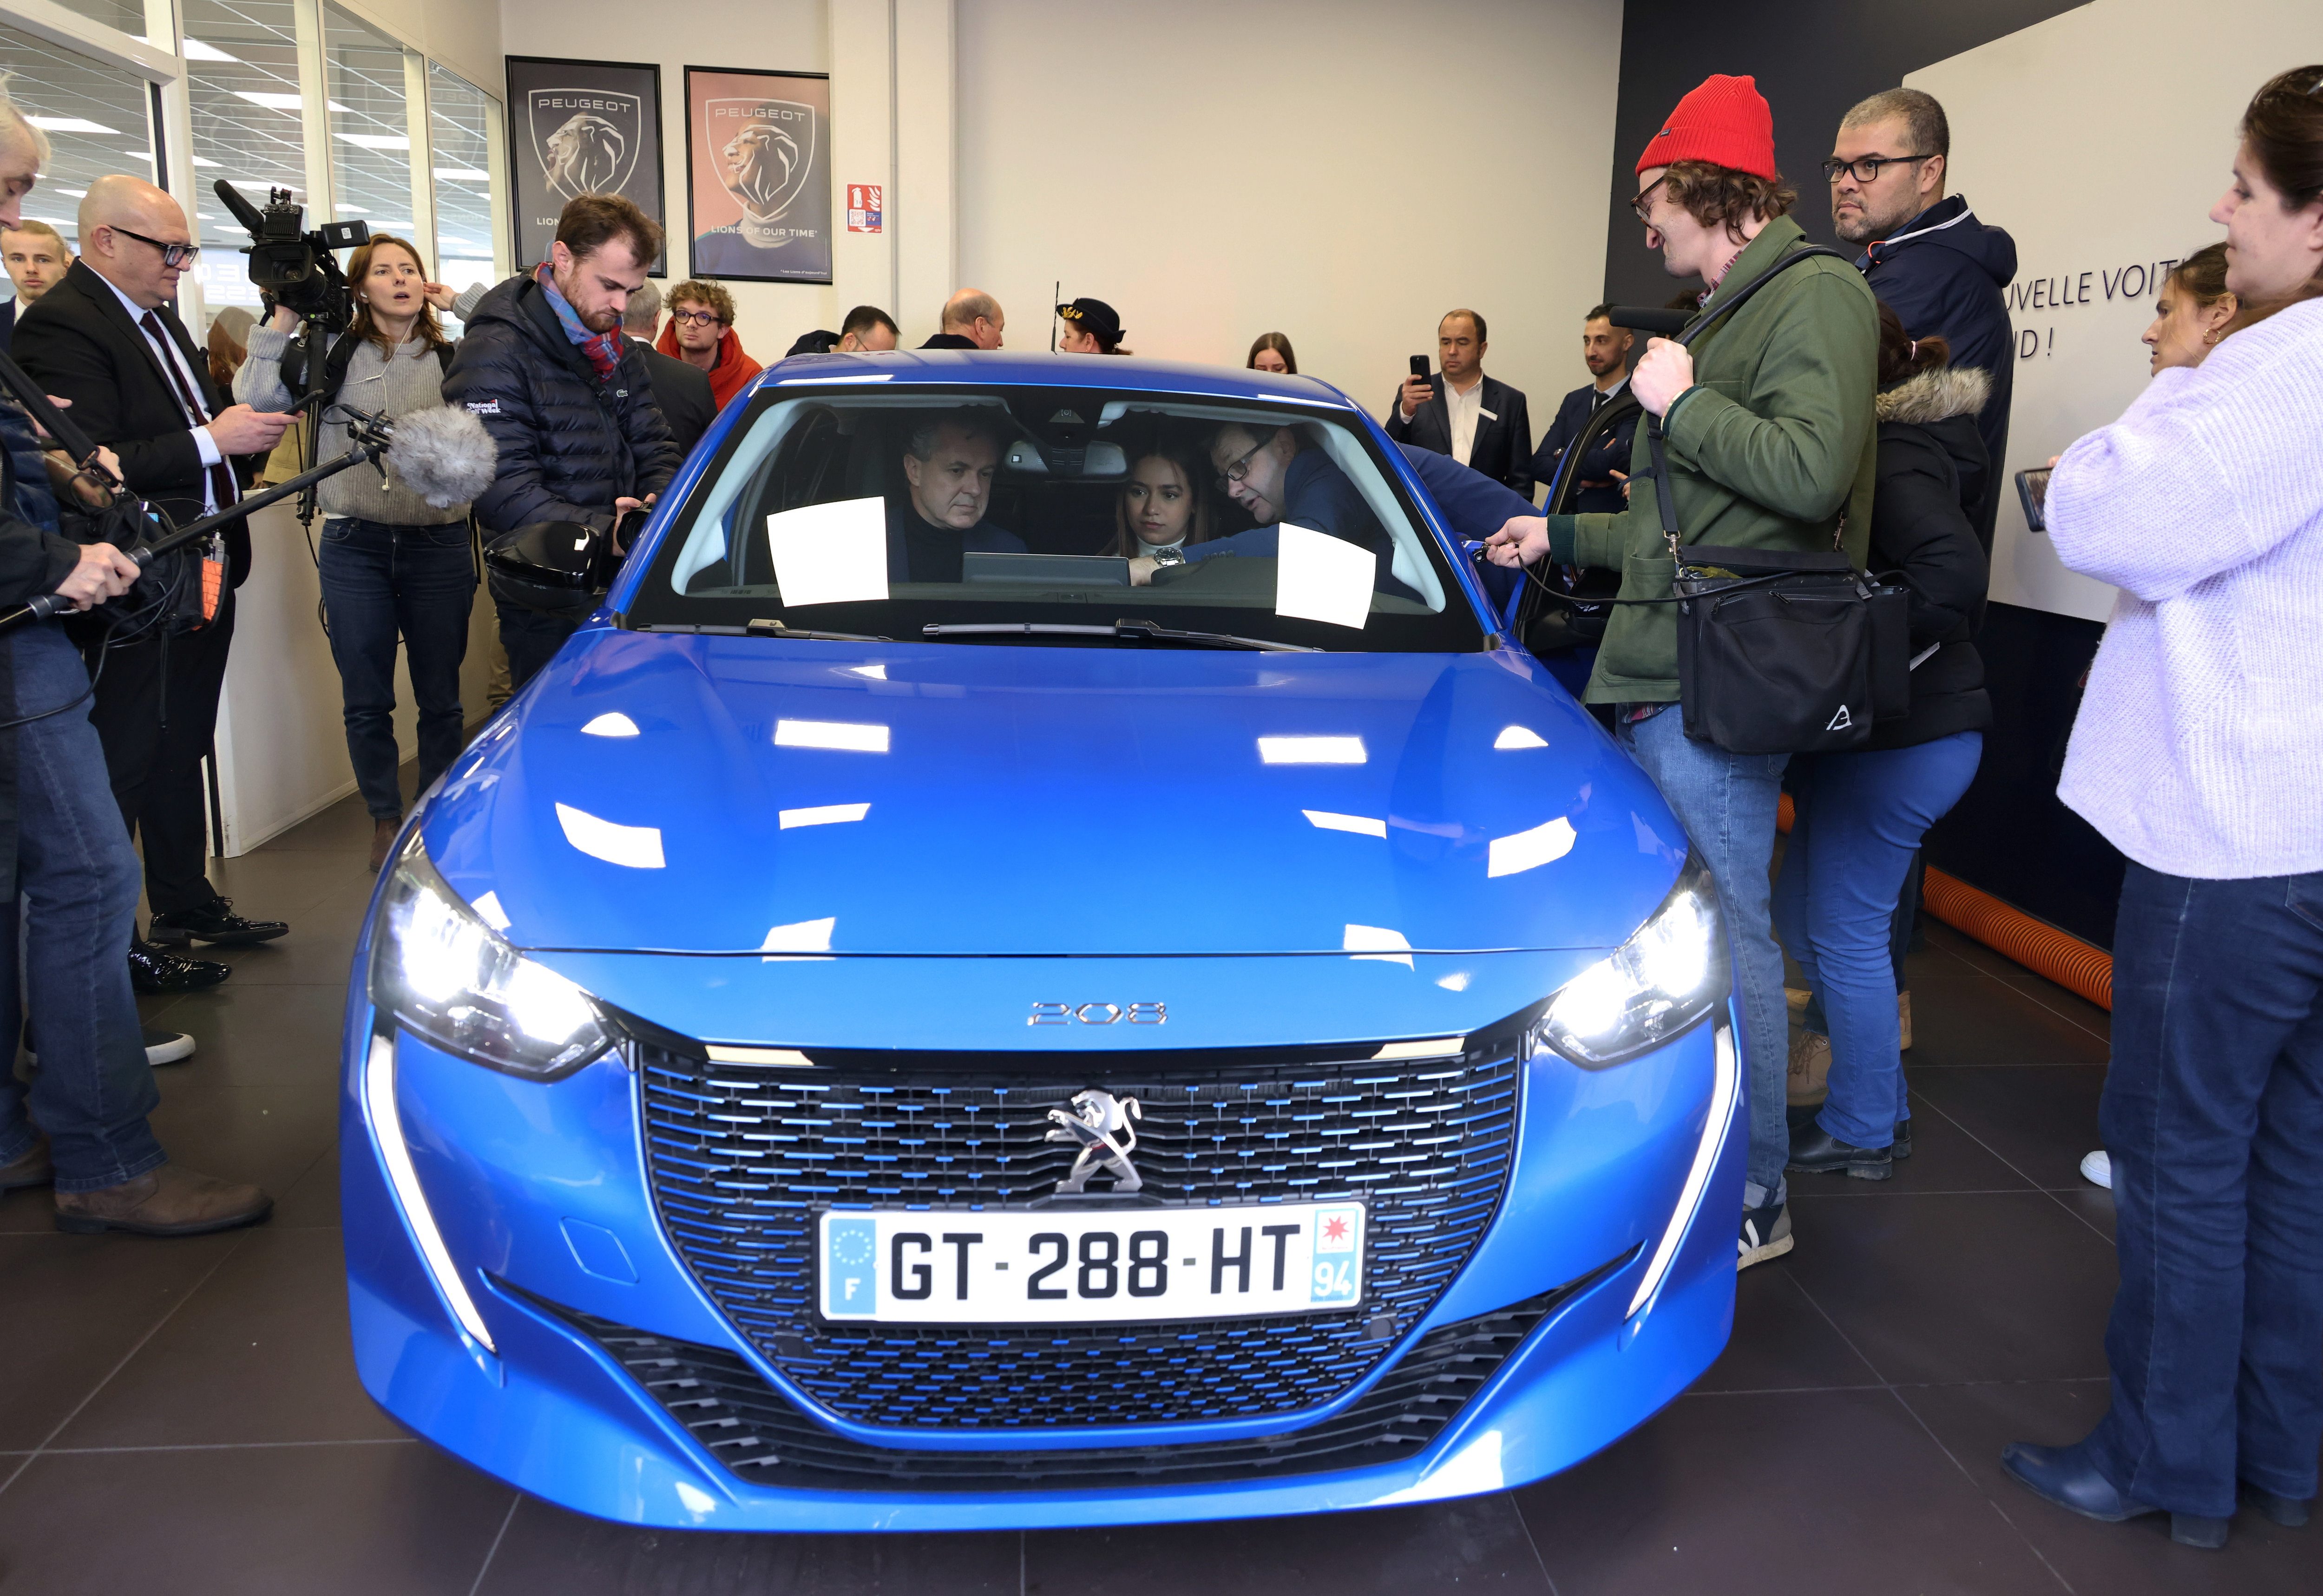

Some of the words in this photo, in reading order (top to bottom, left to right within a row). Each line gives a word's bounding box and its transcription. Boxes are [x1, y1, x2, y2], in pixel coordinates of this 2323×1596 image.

[538, 98, 630, 113] PEUGEOT
[715, 108, 805, 122] PEUGEOT
[537, 217, 559, 226] LION
[711, 225, 742, 234] LIONS
[763, 228, 786, 236] OUR
[2103, 258, 2185, 299] VOIT
[467, 399, 498, 409] National
[1027, 1002, 1168, 1026] 208
[891, 1223, 1301, 1300] GT-288-HT
[1314, 1260, 1352, 1296] 94
[845, 1278, 861, 1300] F
